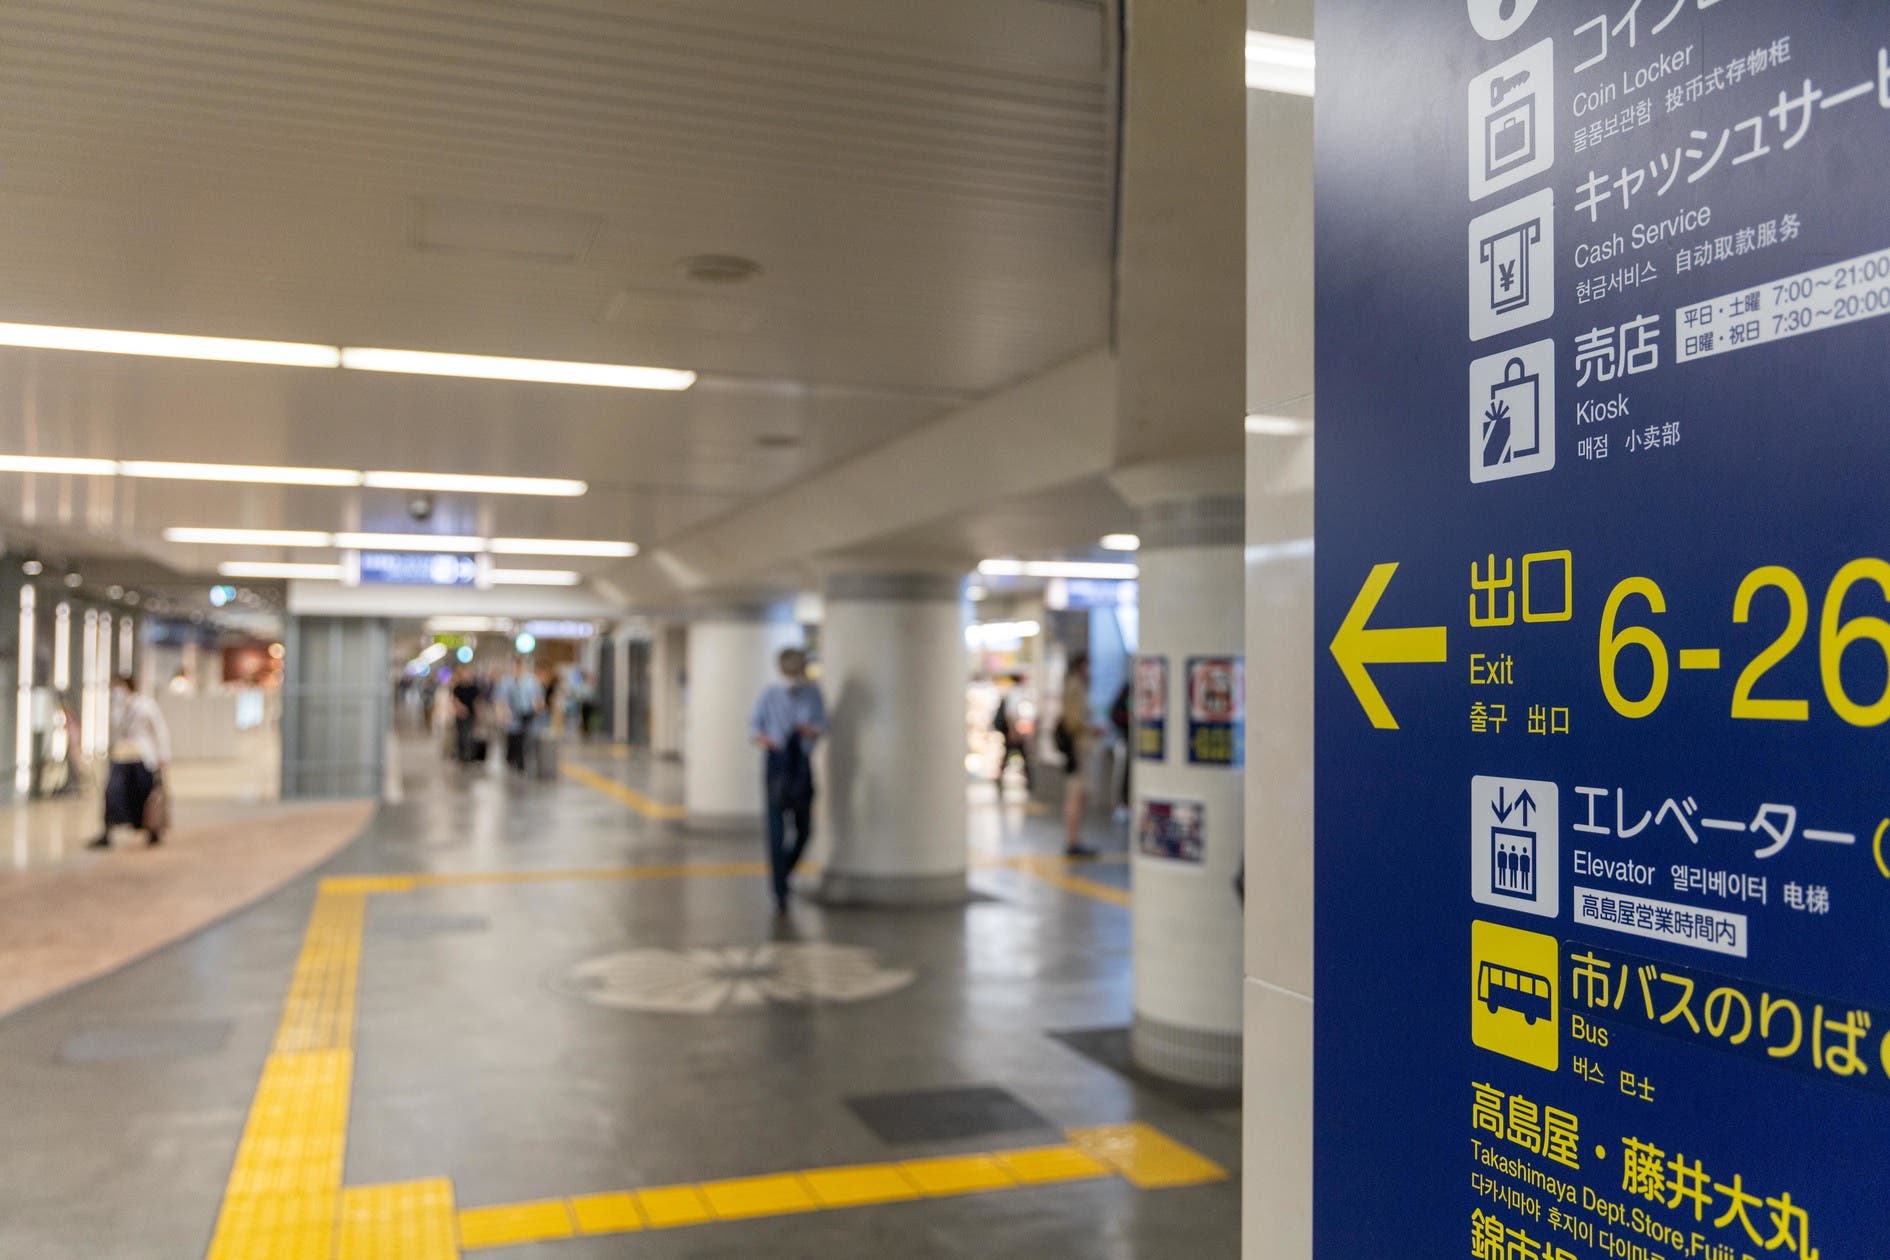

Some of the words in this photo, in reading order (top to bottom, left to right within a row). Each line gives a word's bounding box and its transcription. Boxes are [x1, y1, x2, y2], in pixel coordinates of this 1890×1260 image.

[1572, 82, 1616, 117] Coin
[1623, 44, 1694, 95] Locker
[1573, 97, 1652, 153] 물품보관함
[1665, 36, 1791, 113] 投币式存物柜
[1574, 48, 1890, 223] キャッシュサー
[1574, 232, 1625, 269] Cash
[1631, 205, 1712, 250] Service
[1576, 260, 1657, 305] 현금서비스
[1675, 212, 1801, 275] 自动取款服务
[1574, 313, 1661, 388] 売店
[1576, 393, 1630, 425] Kiosk
[1577, 434, 1609, 461] 매점
[1625, 421, 1681, 453] 小卖部
[1469, 549, 1573, 627] 出口
[1470, 653, 1514, 685] Exit
[1469, 702, 1508, 733] 출구
[1528, 704, 1570, 735] 出口
[1573, 786, 1856, 858] エレベーター
[1574, 850, 1656, 885] Elevator
[1670, 864, 1768, 905] 엘리베이터
[1783, 880, 1830, 915] 电梯
[1582, 894, 1737, 947] 高島屋営業時間内
[1570, 951, 1872, 1076] 市バスのりば
[1571, 1014, 1609, 1047] Bus
[1572, 1055, 1606, 1085] 버스
[1619, 1070, 1656, 1103] 巴士
[1470, 1139, 1577, 1204] Takashimaya
[1470, 1172, 1541, 1222] 다카시마야
[1547, 1206, 1593, 1248] 후지이
